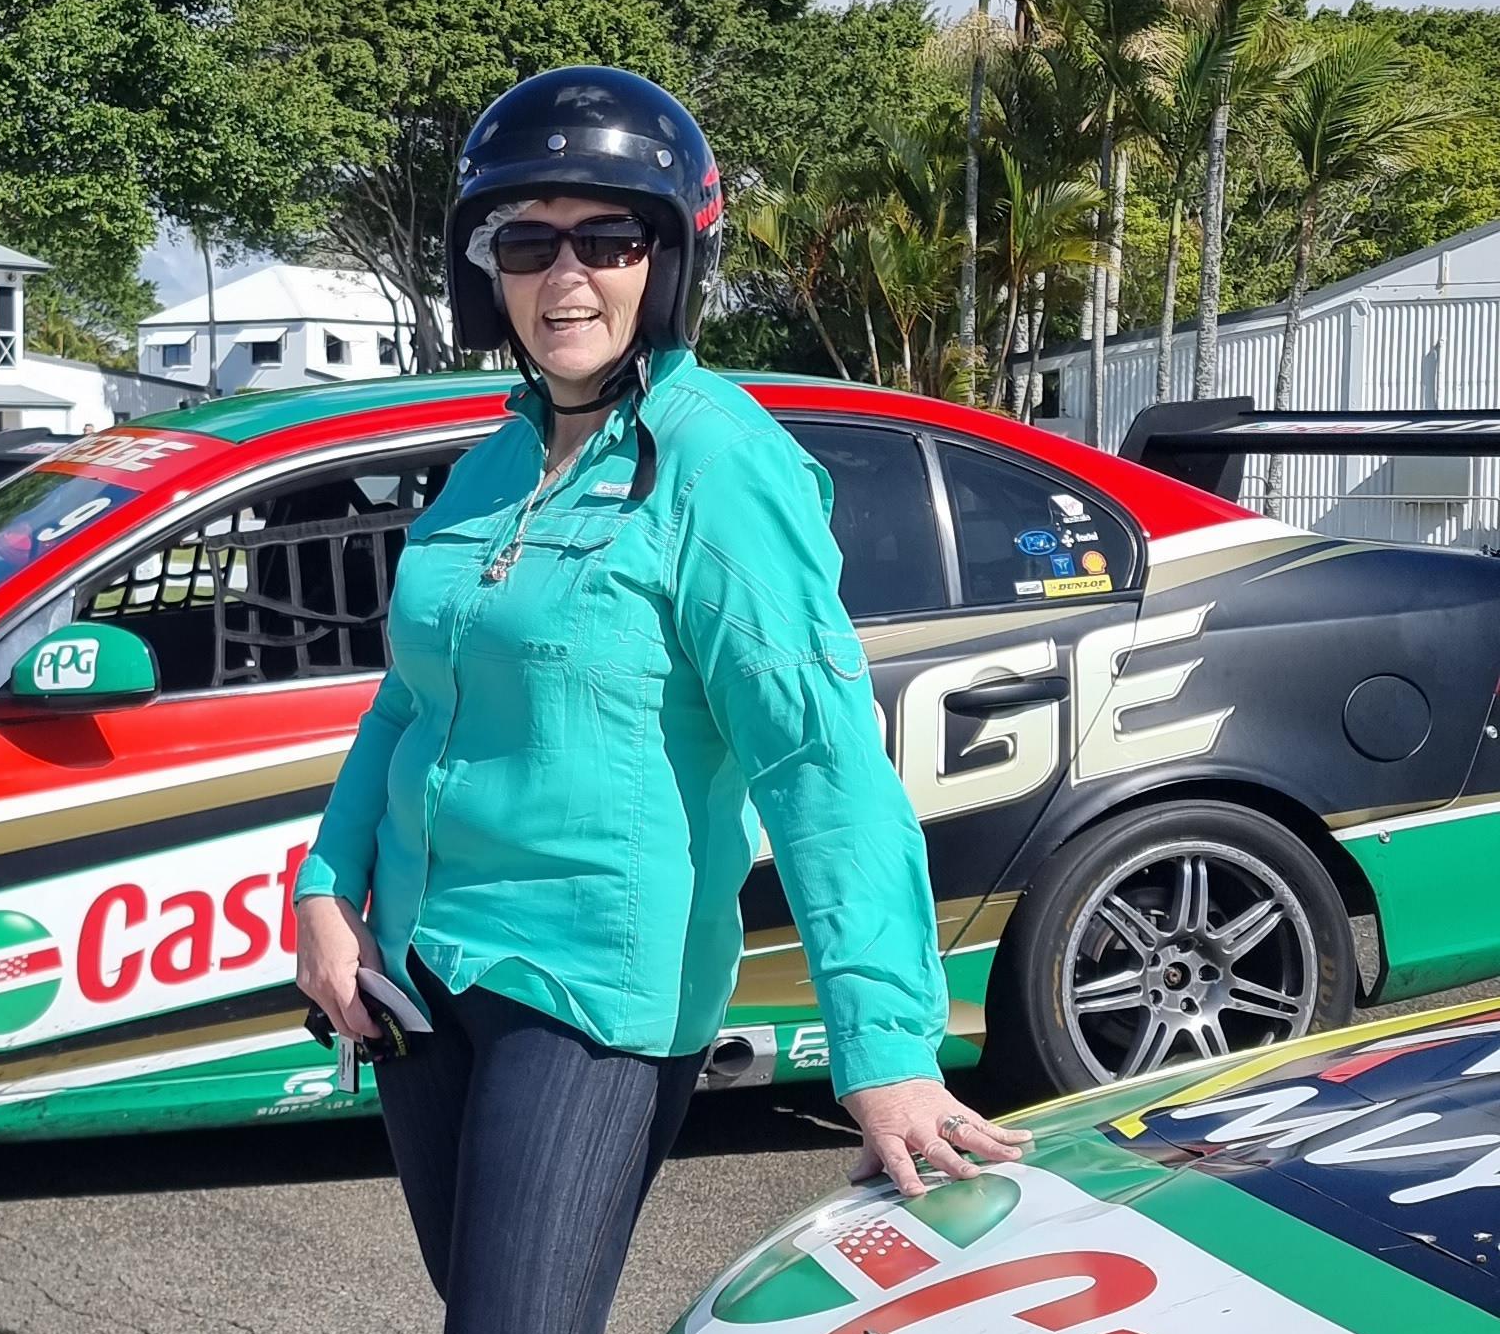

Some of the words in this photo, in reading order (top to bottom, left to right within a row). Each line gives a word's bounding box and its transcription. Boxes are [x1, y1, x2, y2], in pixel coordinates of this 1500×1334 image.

[1058, 579, 1107, 591] DUNLOP
[37, 644, 94, 685] PPG
[874, 602, 1236, 824] GE
